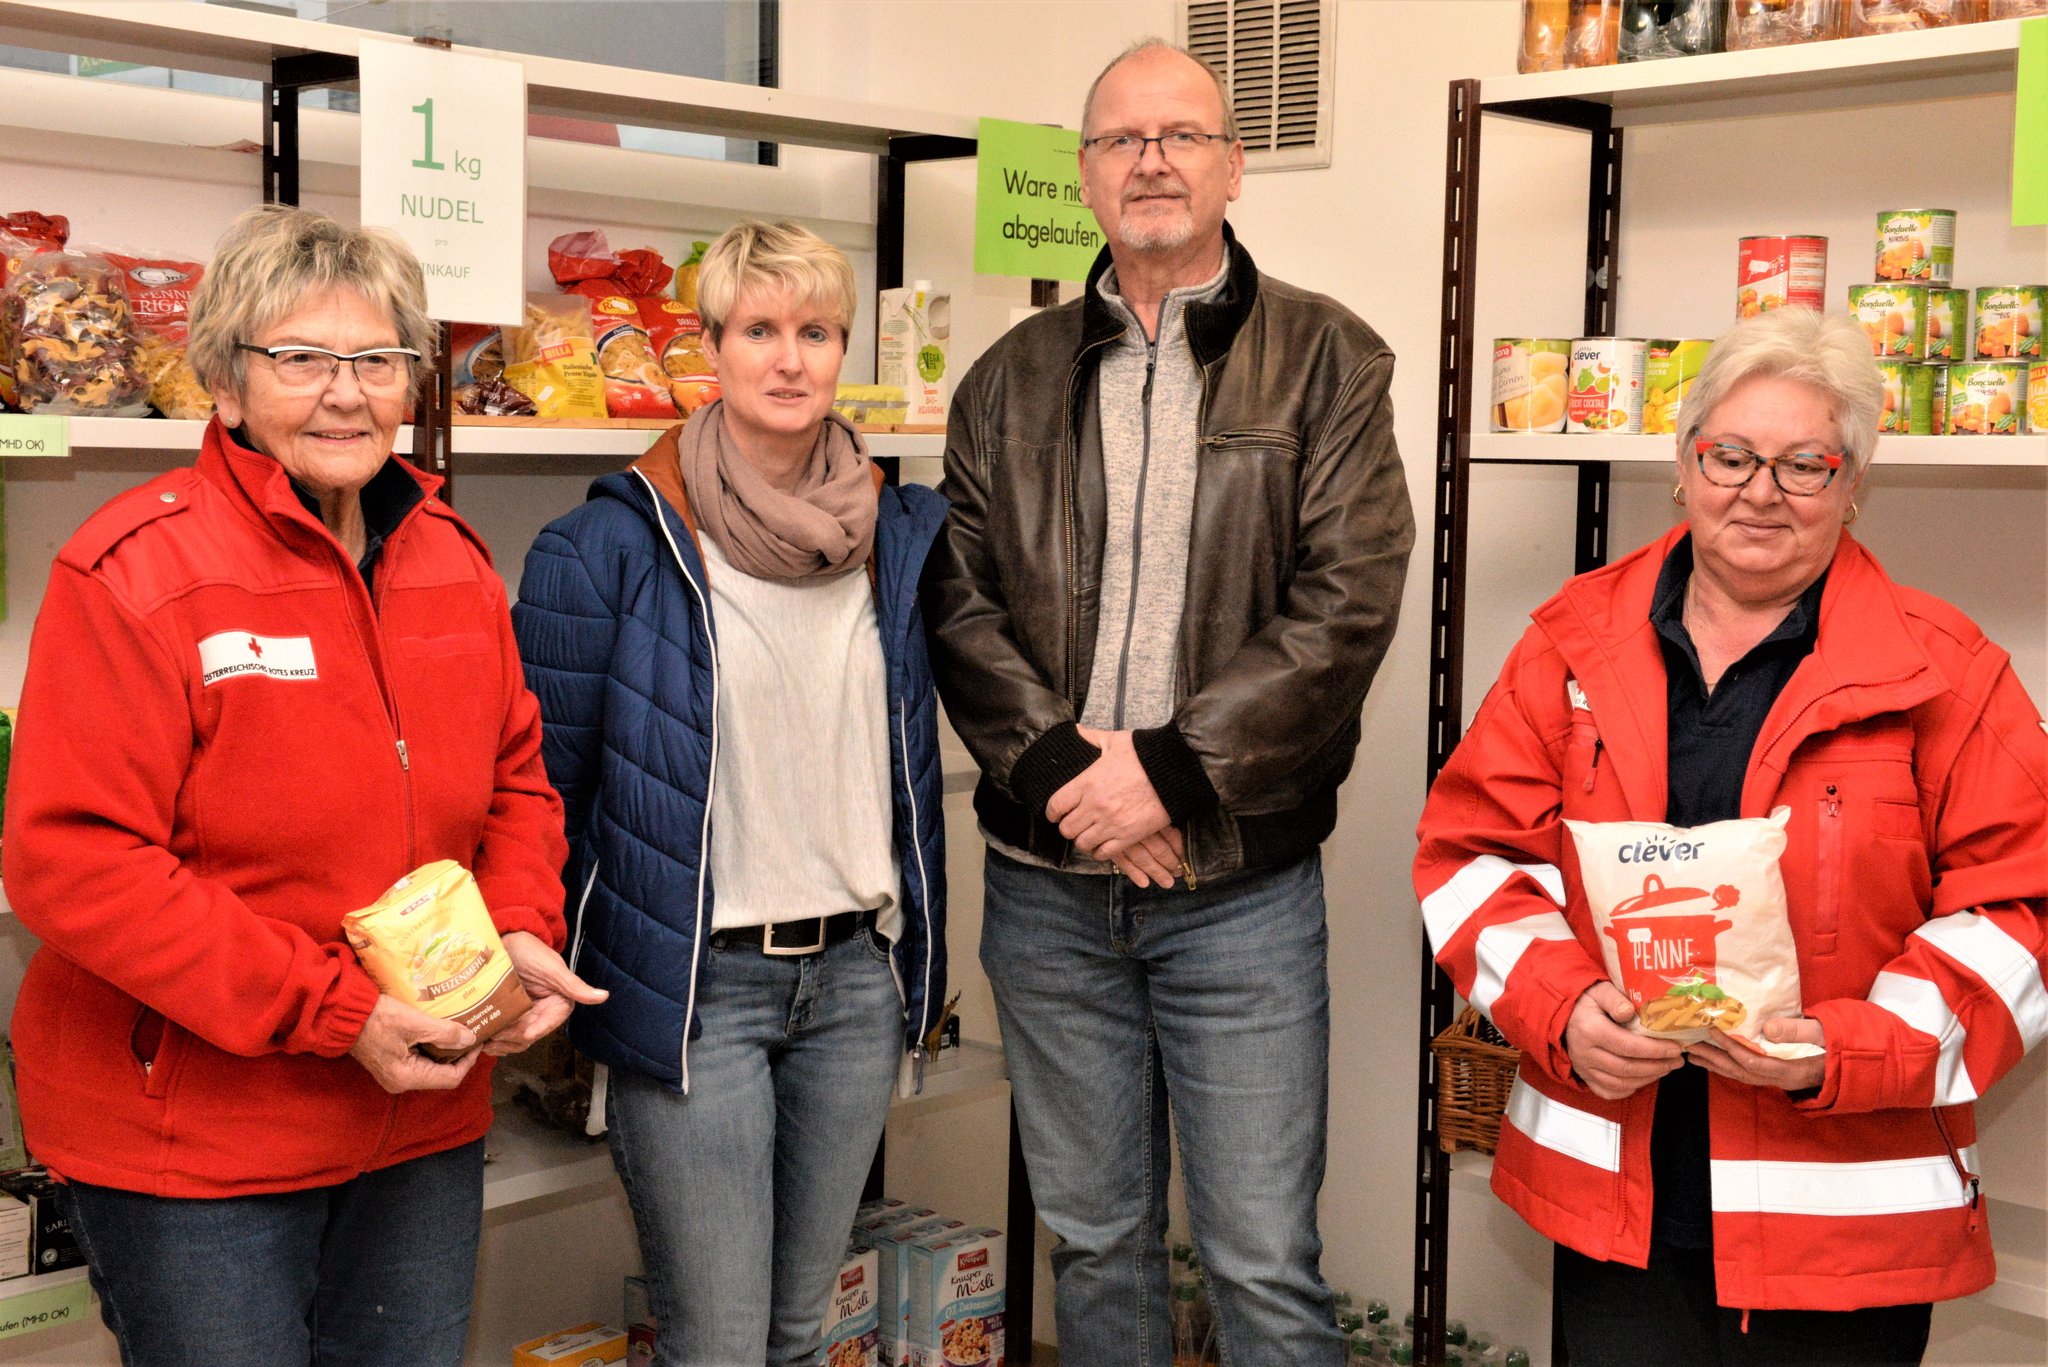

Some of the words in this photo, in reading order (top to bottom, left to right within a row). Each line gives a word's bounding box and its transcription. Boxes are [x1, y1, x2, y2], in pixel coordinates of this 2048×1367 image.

[411, 97, 446, 171] 1
[454, 149, 482, 181] kg
[1002, 167, 1058, 200] Ware
[1063, 180, 1083, 203] nic
[400, 193, 484, 224] NUDEL
[1002, 214, 1099, 249] abgelaufen
[1883, 224, 1918, 234] Bonduelle
[434, 238, 448, 247] pro
[420, 262, 471, 279] INKAUF
[139, 299, 191, 313] RIGAT
[1859, 299, 1896, 310] Bonduelle
[543, 344, 572, 359] BILLA
[1573, 349, 1601, 361] clever
[25, 438, 45, 453] OK)
[290, 667, 317, 677] KREUZ
[1617, 841, 1705, 864] clever
[1632, 937, 1695, 971] PENNE
[429, 954, 488, 997] WEIZENMEHL
[466, 1003, 494, 1026] naturrein
[470, 1023, 482, 1036] ype
[481, 1018, 491, 1030] W
[489, 1009, 502, 1022] 480
[951, 1270, 983, 1286] Knusper
[956, 1272, 996, 1299] Müsli
[835, 1288, 860, 1308] Knusper
[50, 1306, 70, 1320] OK)
